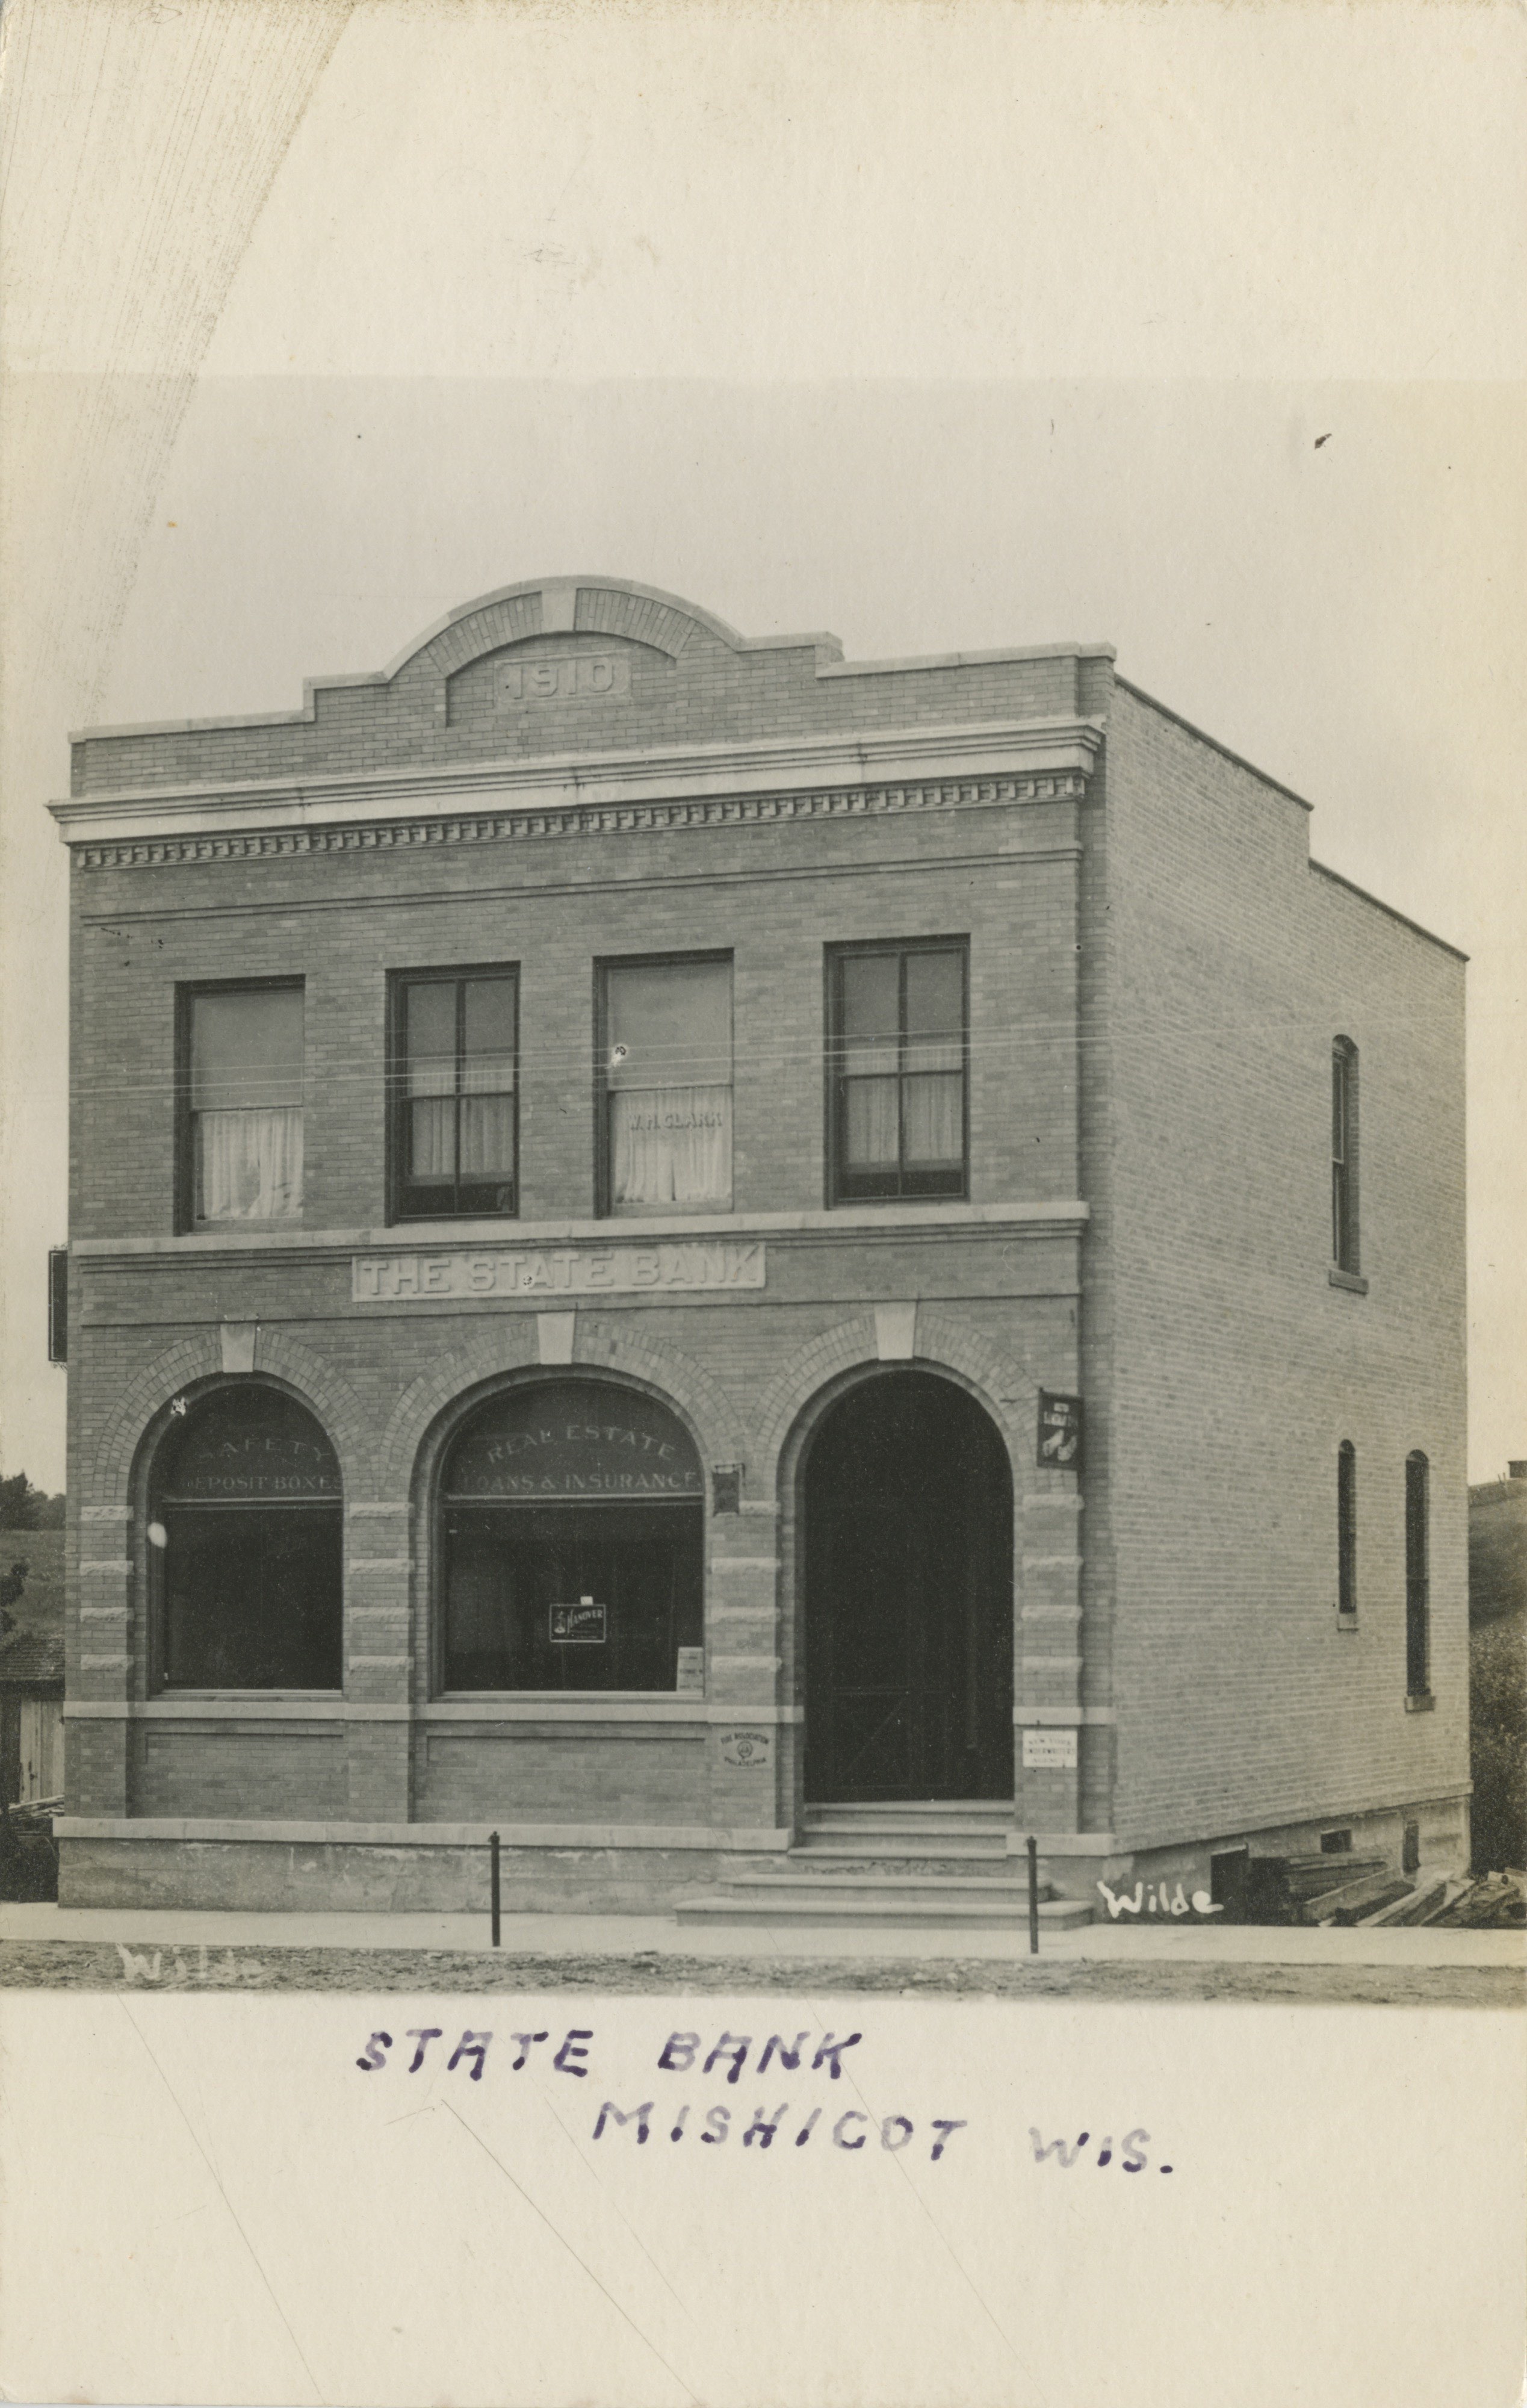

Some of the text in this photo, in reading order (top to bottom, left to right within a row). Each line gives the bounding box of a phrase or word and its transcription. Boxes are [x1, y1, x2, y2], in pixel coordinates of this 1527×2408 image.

[509, 659, 615, 699] 1910
[362, 1243, 759, 1295] THE STATE BANK
[197, 1437, 332, 1464] SAFETY
[487, 1424, 677, 1463] REAL ESTATE
[180, 1476, 268, 1490] DEPOSIT
[463, 1474, 534, 1491] LOANS
[540, 1475, 557, 1490] &
[1097, 1880, 1225, 1919] Wilde
[356, 2028, 863, 2084] STATE BANK
[592, 2100, 1174, 2174] MISHICOT WIS.
